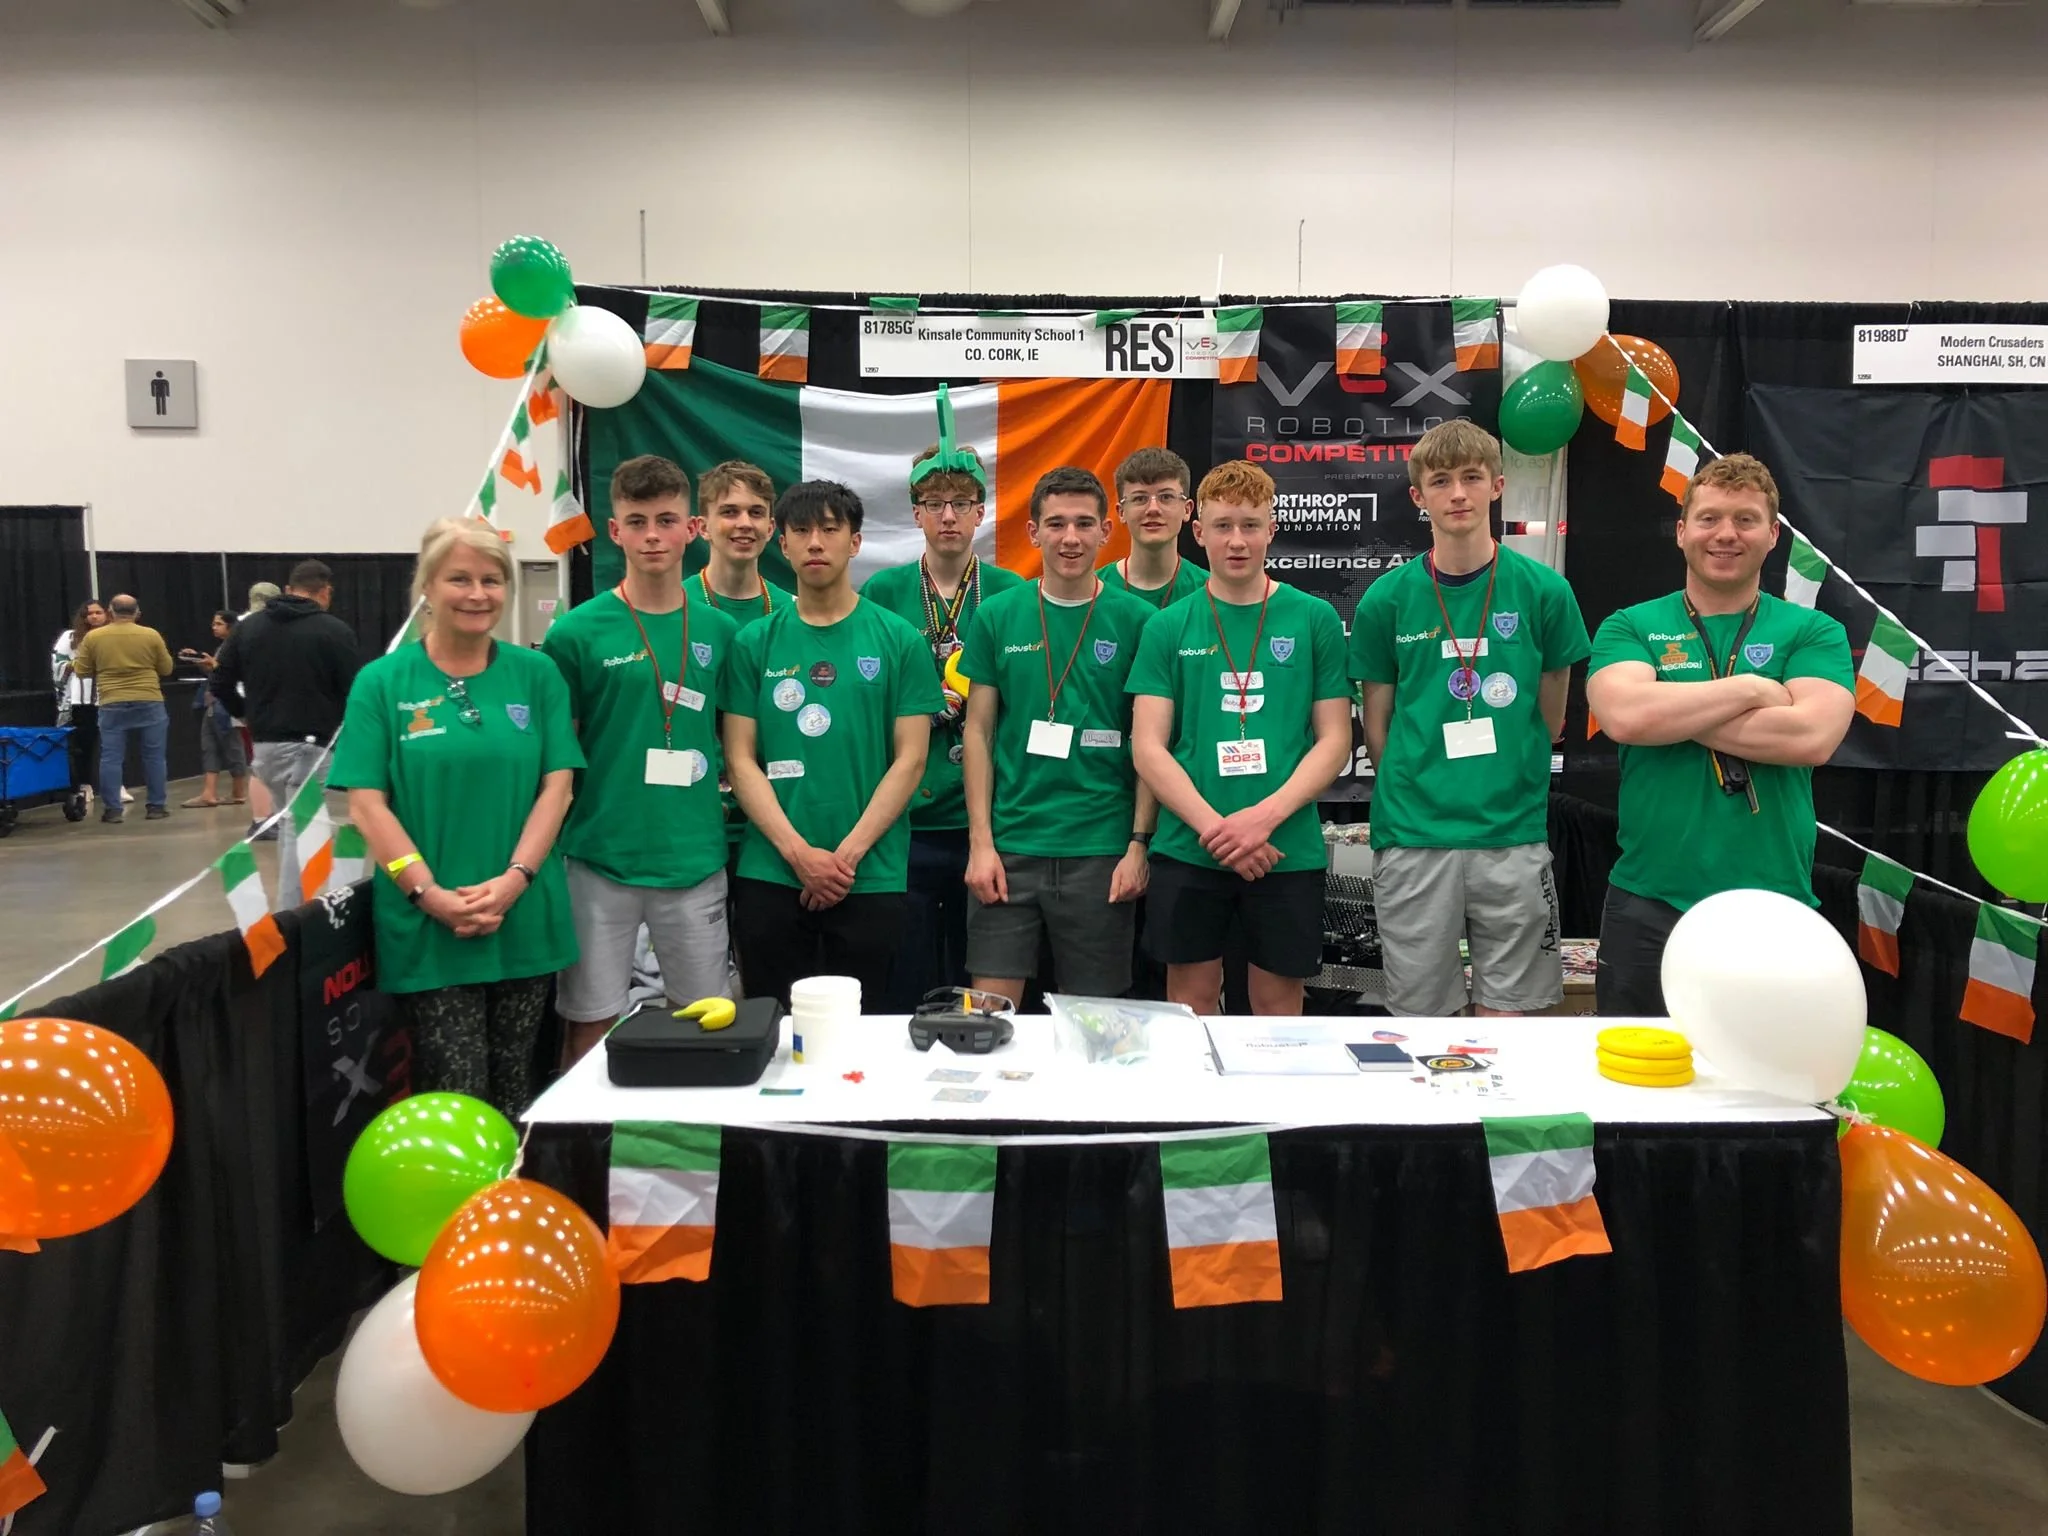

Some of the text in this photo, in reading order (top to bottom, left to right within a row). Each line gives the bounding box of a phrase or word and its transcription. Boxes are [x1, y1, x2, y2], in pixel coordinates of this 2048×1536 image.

[864, 320, 913, 335] 81785G
[918, 328, 1084, 344] Kinsale Community School 1
[1858, 328, 1908, 343] 81988D
[1940, 335, 2044, 349] Modern Crusaders
[1105, 323, 1174, 372] RES
[965, 348, 1039, 363] CO. CORK, IE
[1937, 354, 2046, 369] SHANGHAI, SH, CN
[1247, 416, 1472, 435] ROBOTIC
[1246, 443, 1417, 462] COMPETIT
[1270, 494, 1348, 508] ORTHROP
[1273, 523, 1361, 532] OUNDATION
[1264, 554, 1381, 569] xcellence
[1222, 753, 1261, 764] 2023
